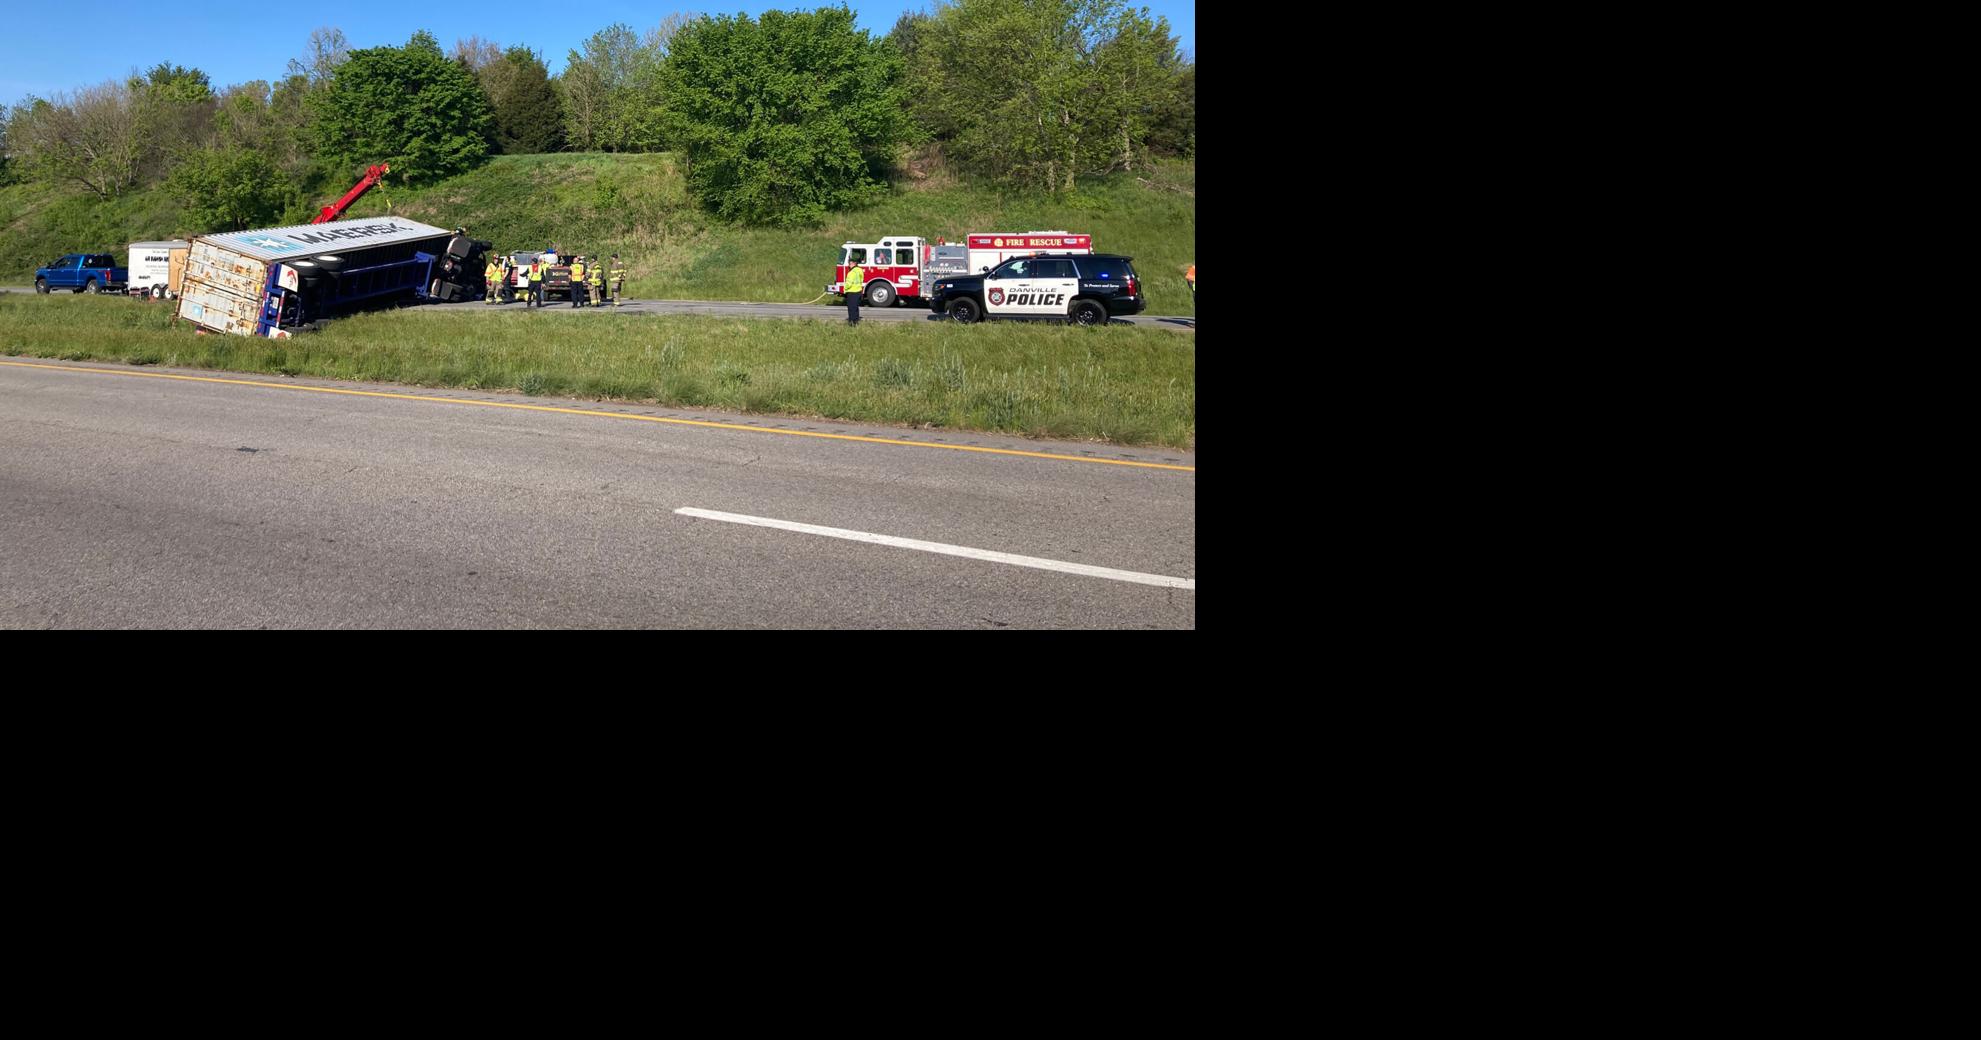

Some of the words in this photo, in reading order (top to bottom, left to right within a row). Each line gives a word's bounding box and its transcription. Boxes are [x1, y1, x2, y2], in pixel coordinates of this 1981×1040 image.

[287, 222, 414, 245] MAERSK
[1006, 238, 1025, 246] FIRE
[1030, 238, 1062, 246] RESCUE
[1006, 293, 1065, 306] POLICE
